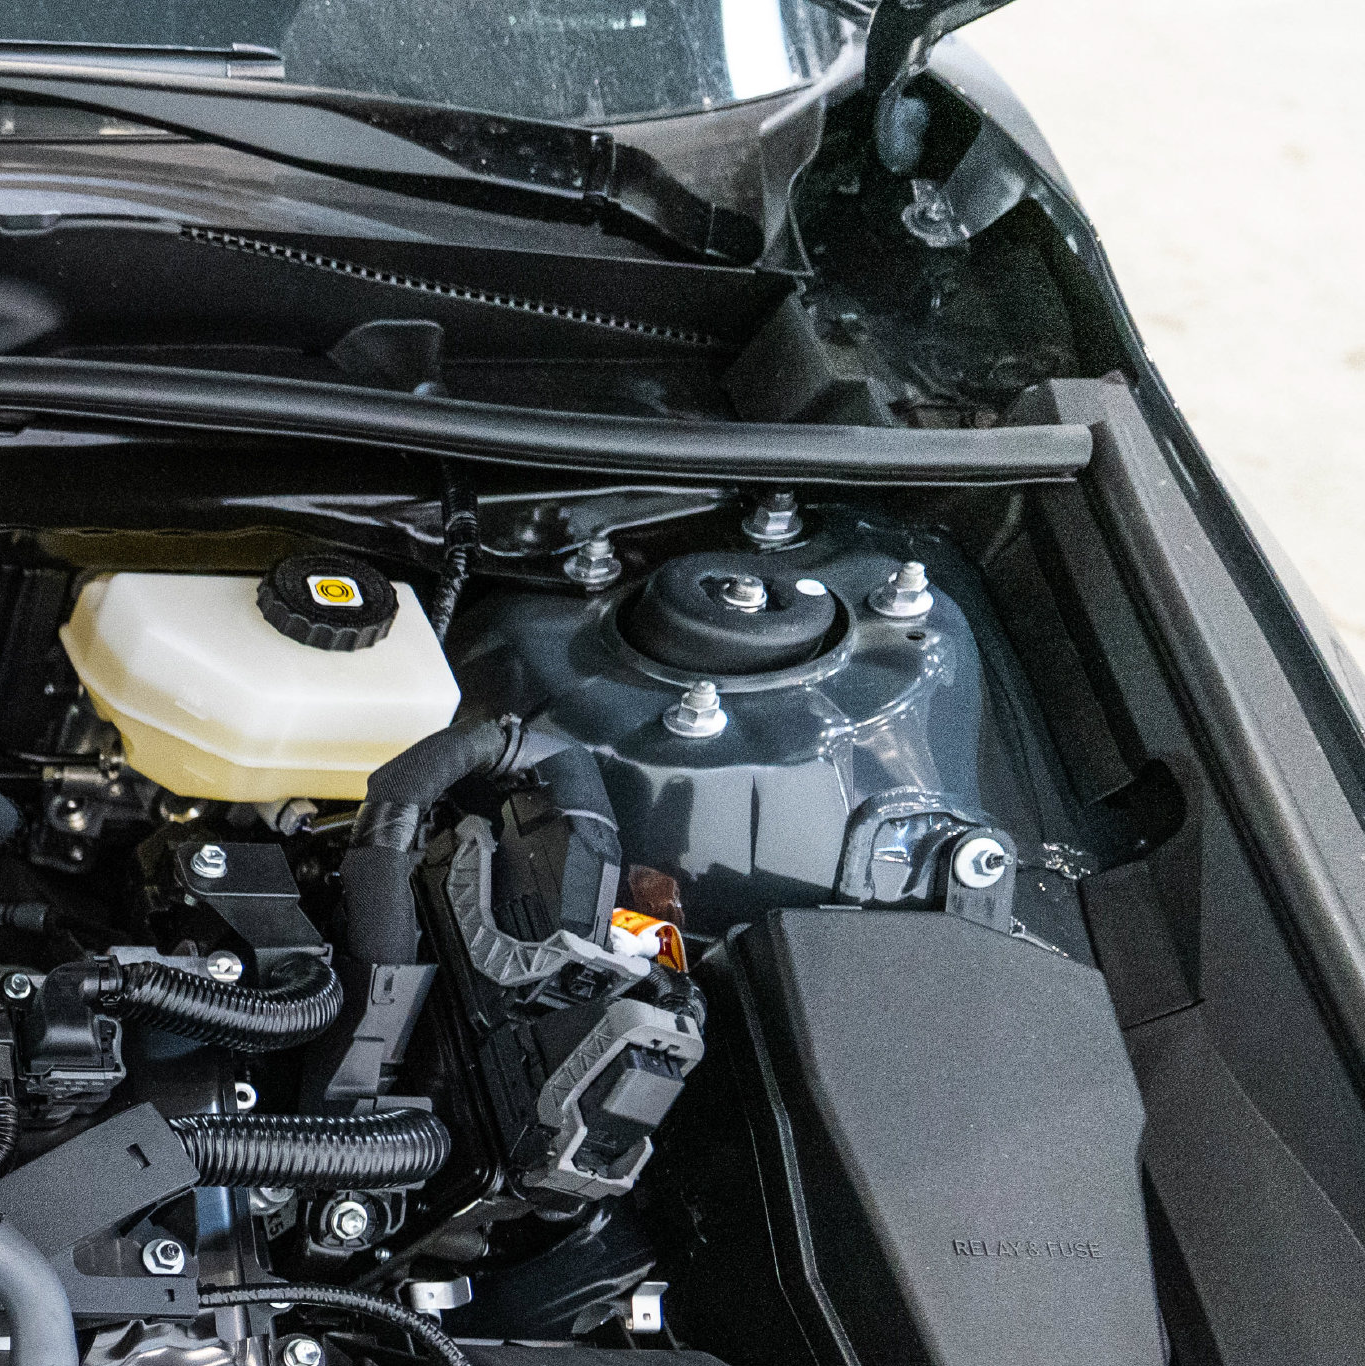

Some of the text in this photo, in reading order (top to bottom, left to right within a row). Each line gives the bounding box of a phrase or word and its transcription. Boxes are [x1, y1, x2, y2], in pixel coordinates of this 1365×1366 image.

[952, 1238, 1104, 1259] RELAY & FUSE
